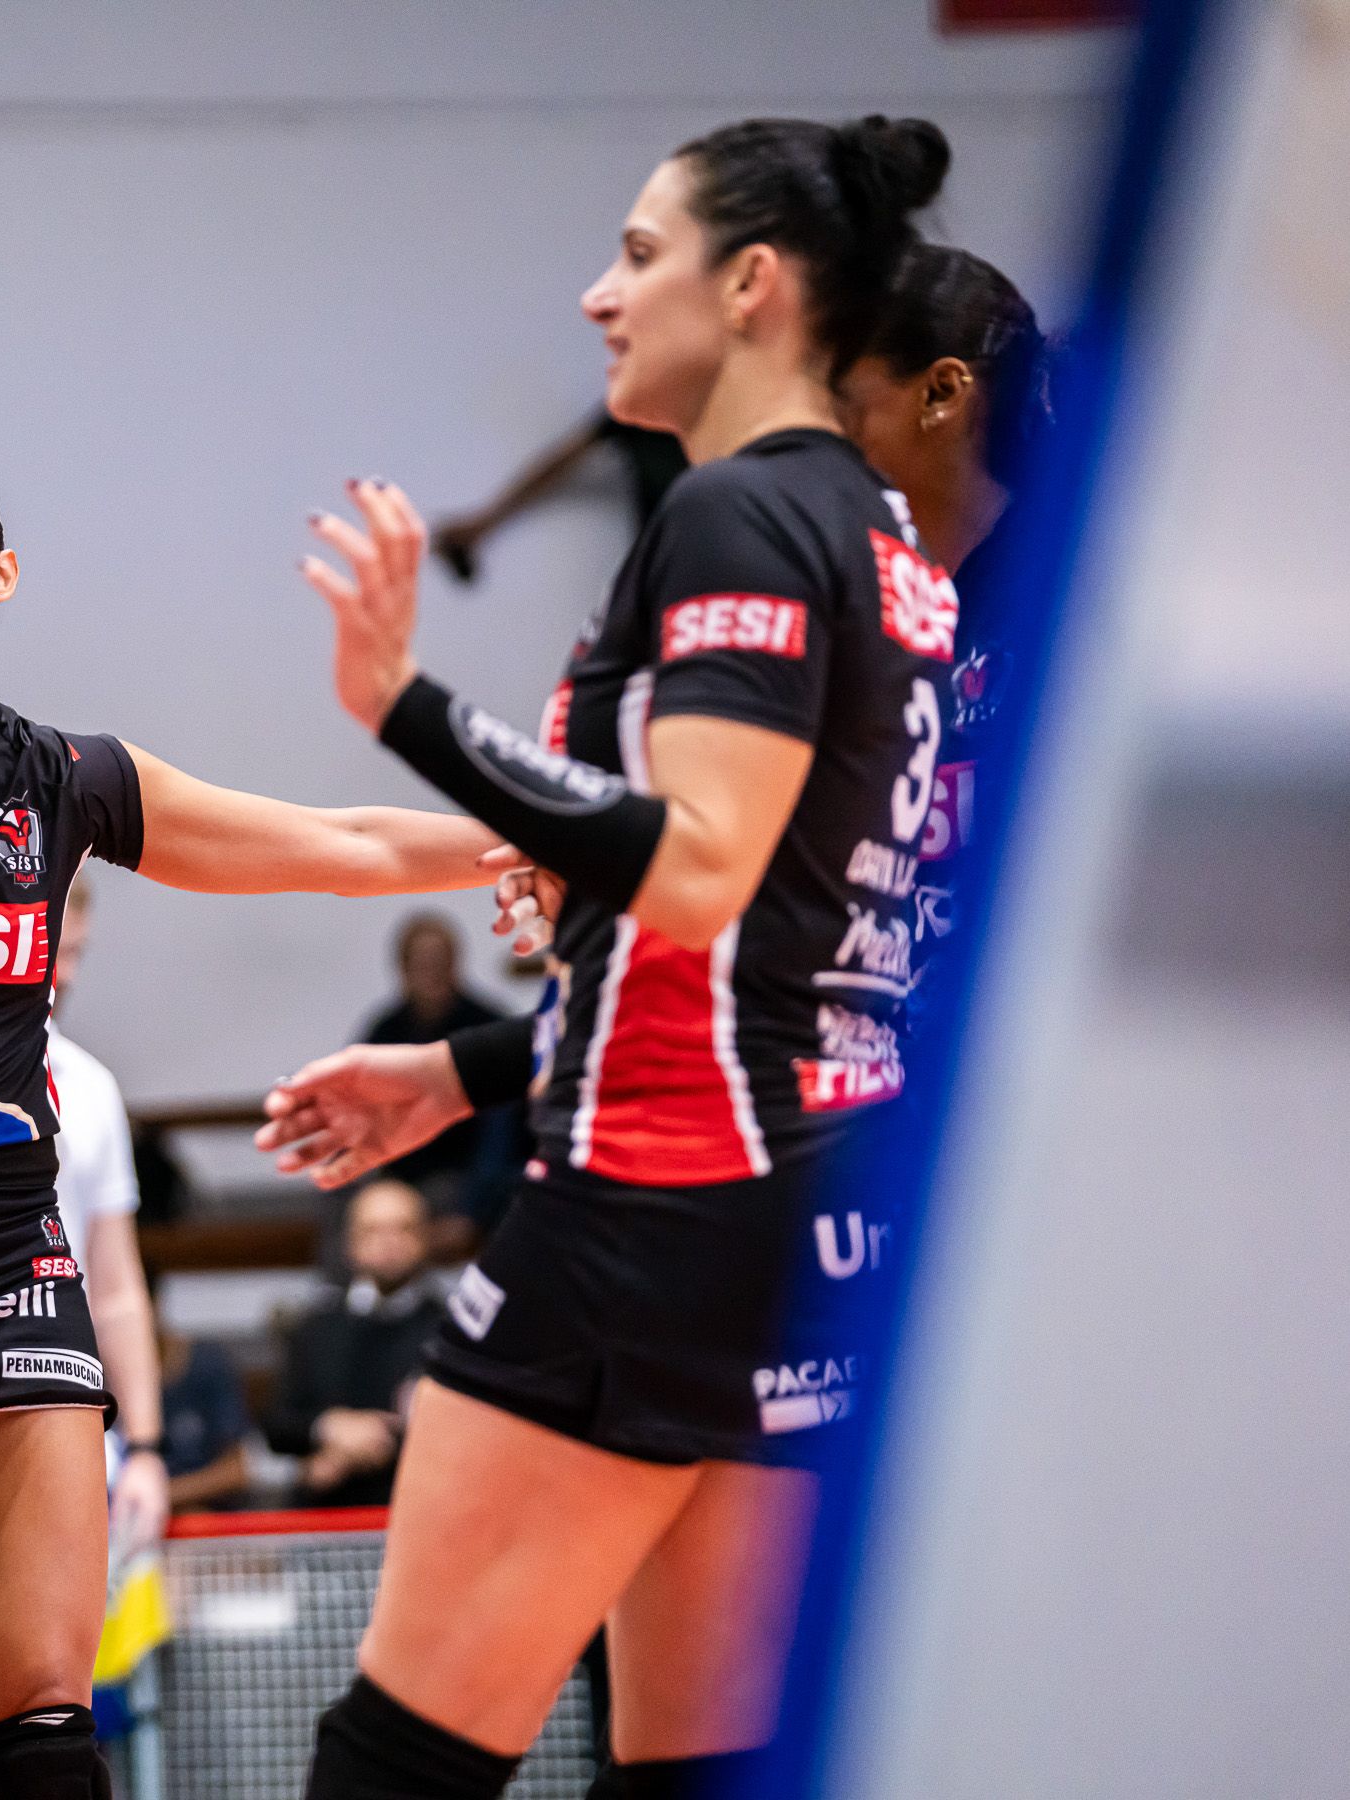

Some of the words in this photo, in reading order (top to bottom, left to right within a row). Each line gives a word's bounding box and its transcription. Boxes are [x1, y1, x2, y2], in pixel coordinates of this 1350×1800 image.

[669, 597, 793, 654] SESI
[892, 676, 942, 845] 3
[6, 855, 41, 871] SESI
[39, 1258, 76, 1278] SESI
[6, 1357, 102, 1389] PERNAMBUCANA
